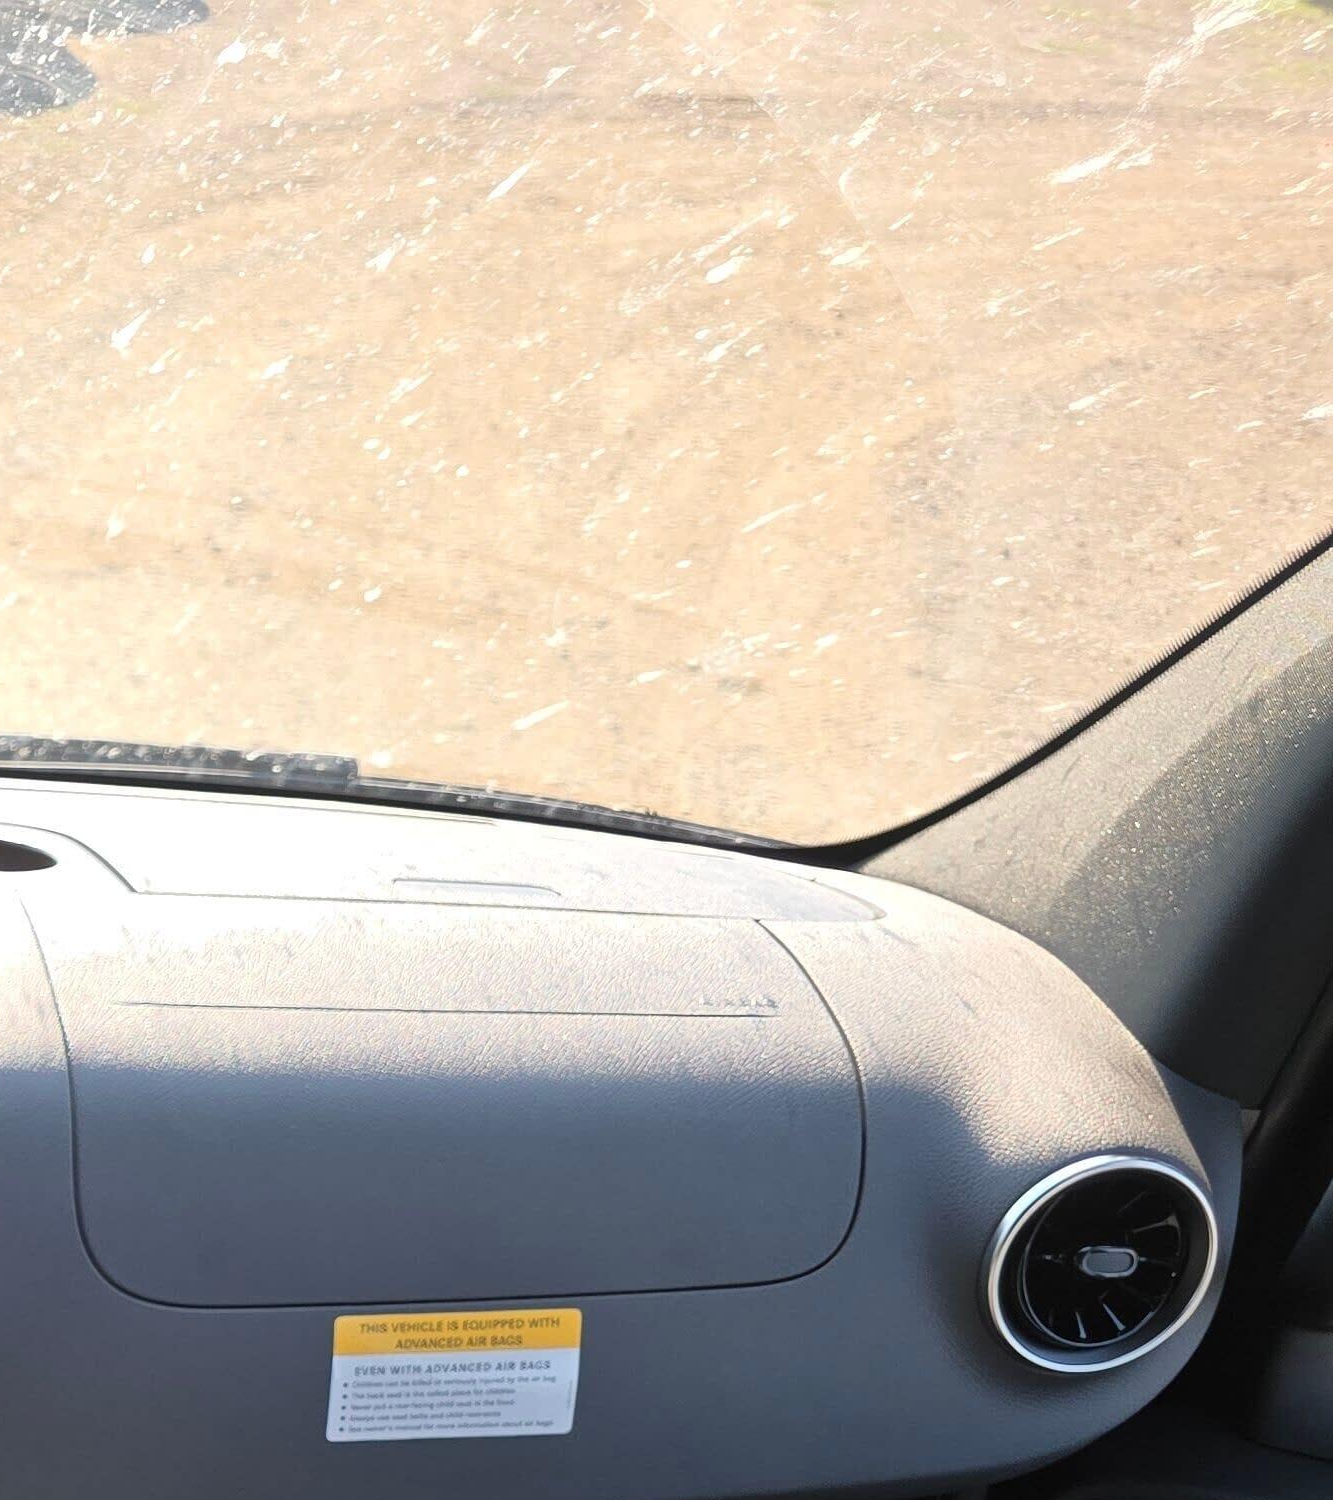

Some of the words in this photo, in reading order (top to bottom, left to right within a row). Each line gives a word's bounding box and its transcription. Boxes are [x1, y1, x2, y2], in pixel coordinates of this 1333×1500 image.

[359, 1322, 387, 1334] THIS
[391, 1320, 443, 1333] VEHICLE
[446, 1319, 459, 1331] IS
[462, 1318, 524, 1331] EQUIPPED
[528, 1316, 560, 1329] WITH
[395, 1337, 463, 1349] ADVANCED
[467, 1335, 487, 1346] AIR
[490, 1334, 523, 1346] BAGS
[354, 1365, 386, 1376] EVEN
[389, 1363, 422, 1375] WITH
[424, 1361, 492, 1373] ADVANCED
[495, 1360, 515, 1371] AIR
[519, 1360, 550, 1371] BAGS
